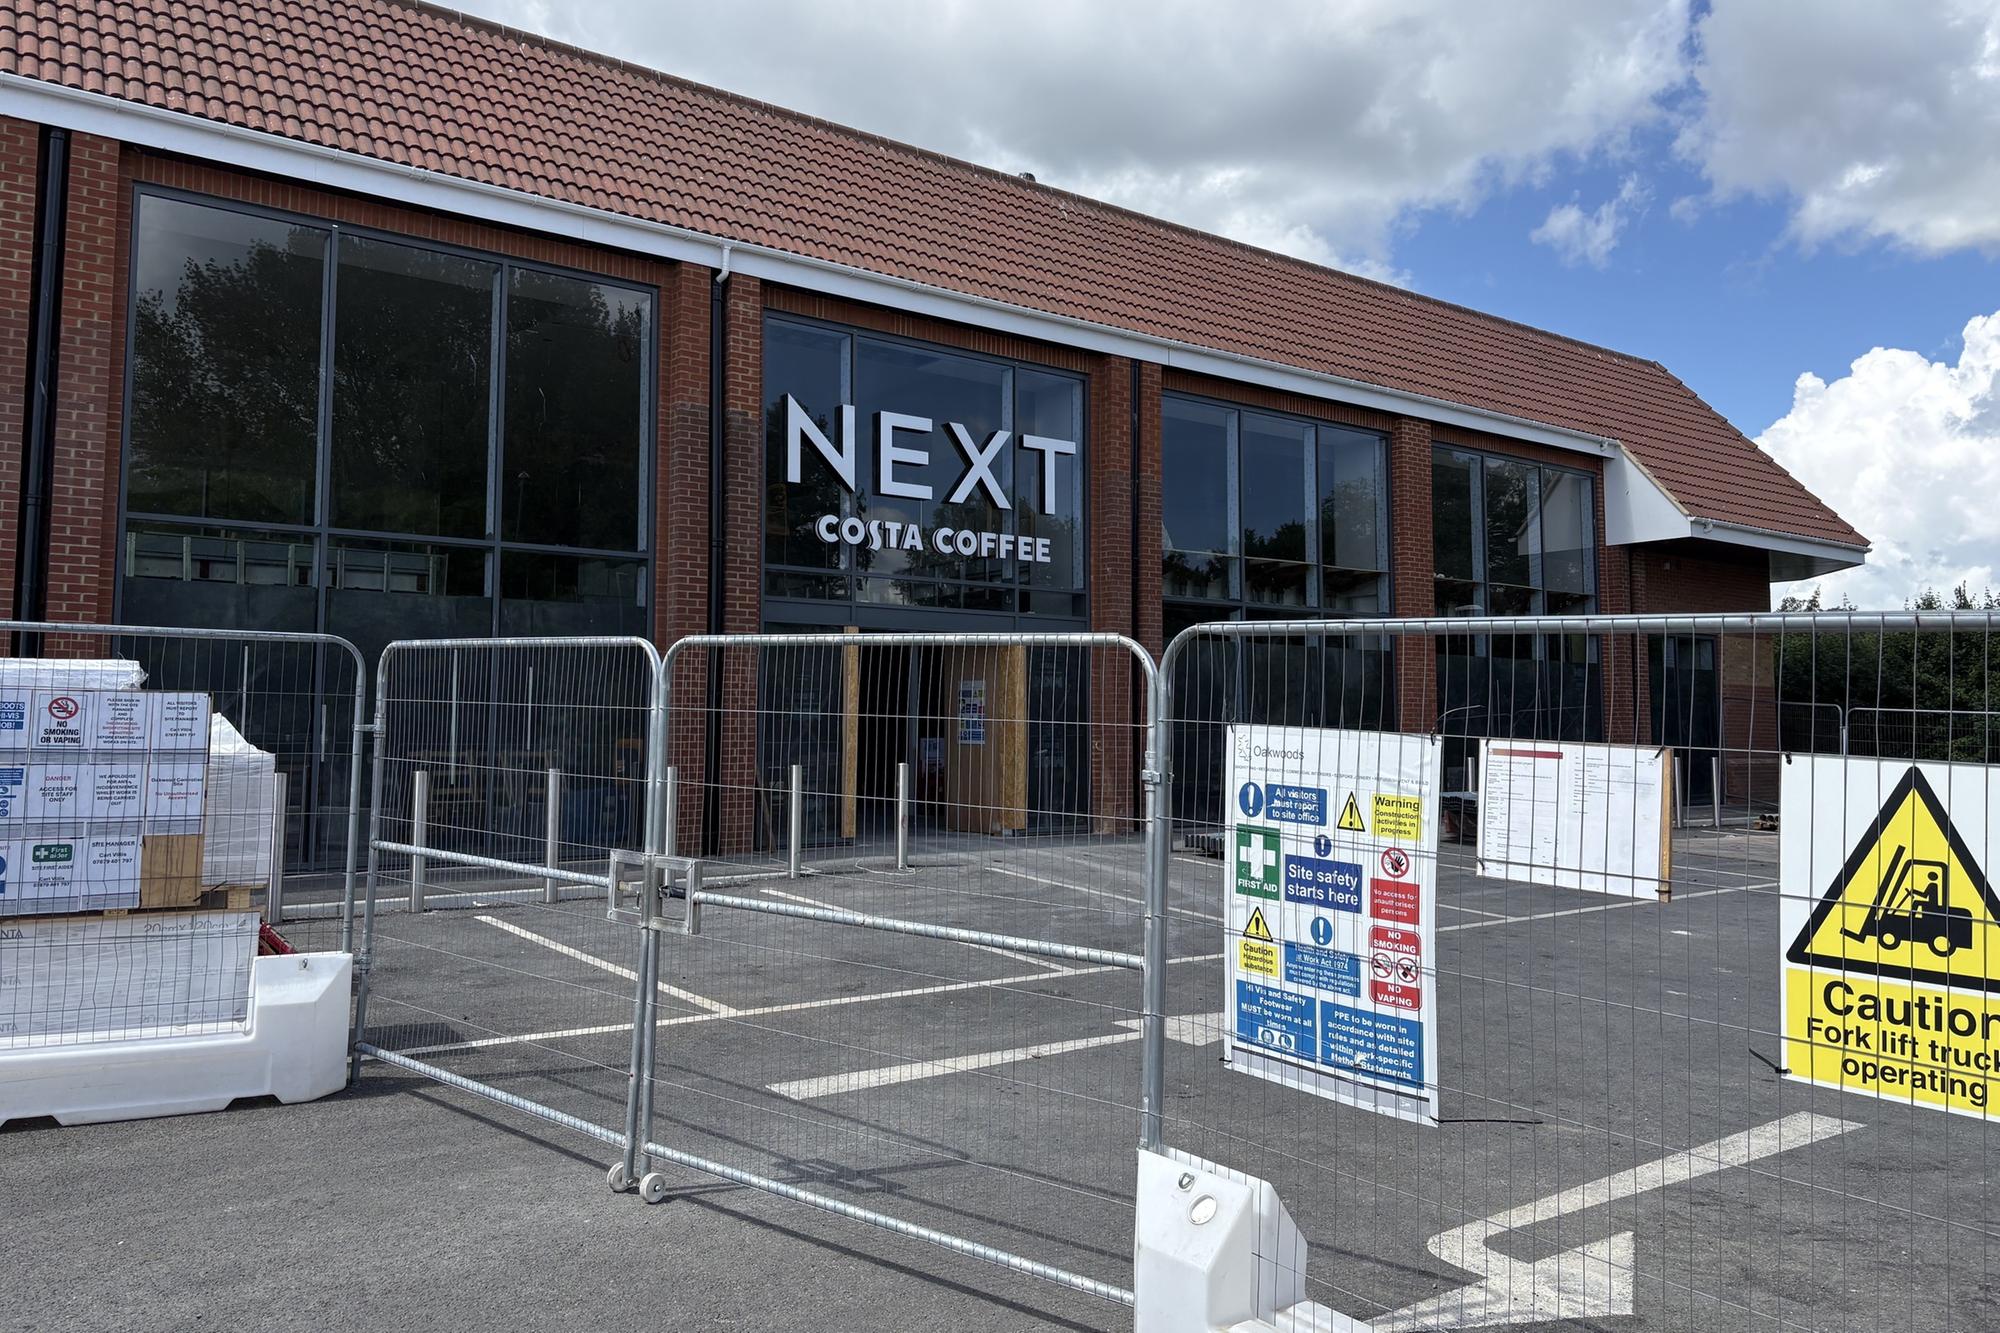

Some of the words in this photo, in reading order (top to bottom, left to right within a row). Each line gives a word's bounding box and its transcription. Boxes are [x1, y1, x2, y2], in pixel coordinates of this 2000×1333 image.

[784, 393, 1076, 515] NEXT
[816, 514, 923, 551] COSTA
[932, 527, 1051, 563] COFFEE
[56, 720, 67, 728] NO
[43, 728, 79, 736] SMOKING
[40, 736, 51, 744] OR
[53, 736, 81, 744] VAPING
[1253, 745, 1305, 760] Oakwoods
[1275, 787, 1286, 798] All
[1272, 798, 1293, 809] must
[1375, 796, 1420, 812] Warning
[1272, 809, 1280, 818] to
[1282, 810, 1296, 820] site
[1298, 812, 1320, 823] office
[1375, 810, 1419, 819] Construction
[1377, 818, 1407, 827] activities
[1409, 819, 1416, 827] in
[1380, 827, 1412, 836] progress
[1288, 864, 1313, 881] Site
[1317, 869, 1358, 891] safety
[1238, 878, 1261, 890] FIRST
[1263, 882, 1278, 893] AID
[1288, 882, 1325, 900] starts
[1329, 887, 1359, 906] here
[1383, 890, 1406, 899] access
[1387, 930, 1401, 941] NO
[1243, 942, 1274, 957] Caution
[1373, 939, 1417, 954] SMOKING
[1243, 953, 1274, 966] Hazardous
[1303, 953, 1319, 964] Work
[1321, 958, 1332, 968] Act
[1334, 960, 1349, 971] 1974
[1244, 962, 1274, 974] substance
[1246, 983, 1254, 992] Hi
[1255, 985, 1267, 995] Vis
[1268, 990, 1281, 998] and
[1283, 992, 1306, 1007] Safety
[1387, 984, 1402, 994] NO
[1259, 997, 1293, 1012] Footwear
[1377, 993, 1413, 1007] VAPING
[1241, 1002, 1262, 1015] MUST
[1264, 1008, 1273, 1017] be
[1274, 1012, 1293, 1023] worn
[1294, 1017, 1302, 1025] at
[1303, 1018, 1313, 1027] all
[1823, 980, 2000, 1043] Caution
[1334, 1010, 1350, 1022] PPE
[1351, 1015, 1360, 1024] to
[1362, 1017, 1373, 1027] be
[1375, 1022, 1397, 1032] worn
[1399, 1025, 1407, 1035] in
[1327, 1021, 1375, 1038] accordance
[1376, 1033, 1396, 1043] with
[1397, 1036, 1415, 1047] site
[1807, 1017, 1872, 1050] Fork
[1881, 1030, 1919, 1058] lift
[1328, 1032, 1348, 1043] rules
[1349, 1037, 1365, 1047] and
[1366, 1042, 1376, 1050] as
[1378, 1043, 1415, 1059] detailed
[1329, 1042, 1354, 1056] within
[1330, 1052, 1357, 1067] Metho
[1361, 1061, 1412, 1080] Statements
[1841, 1058, 1988, 1107] operating
